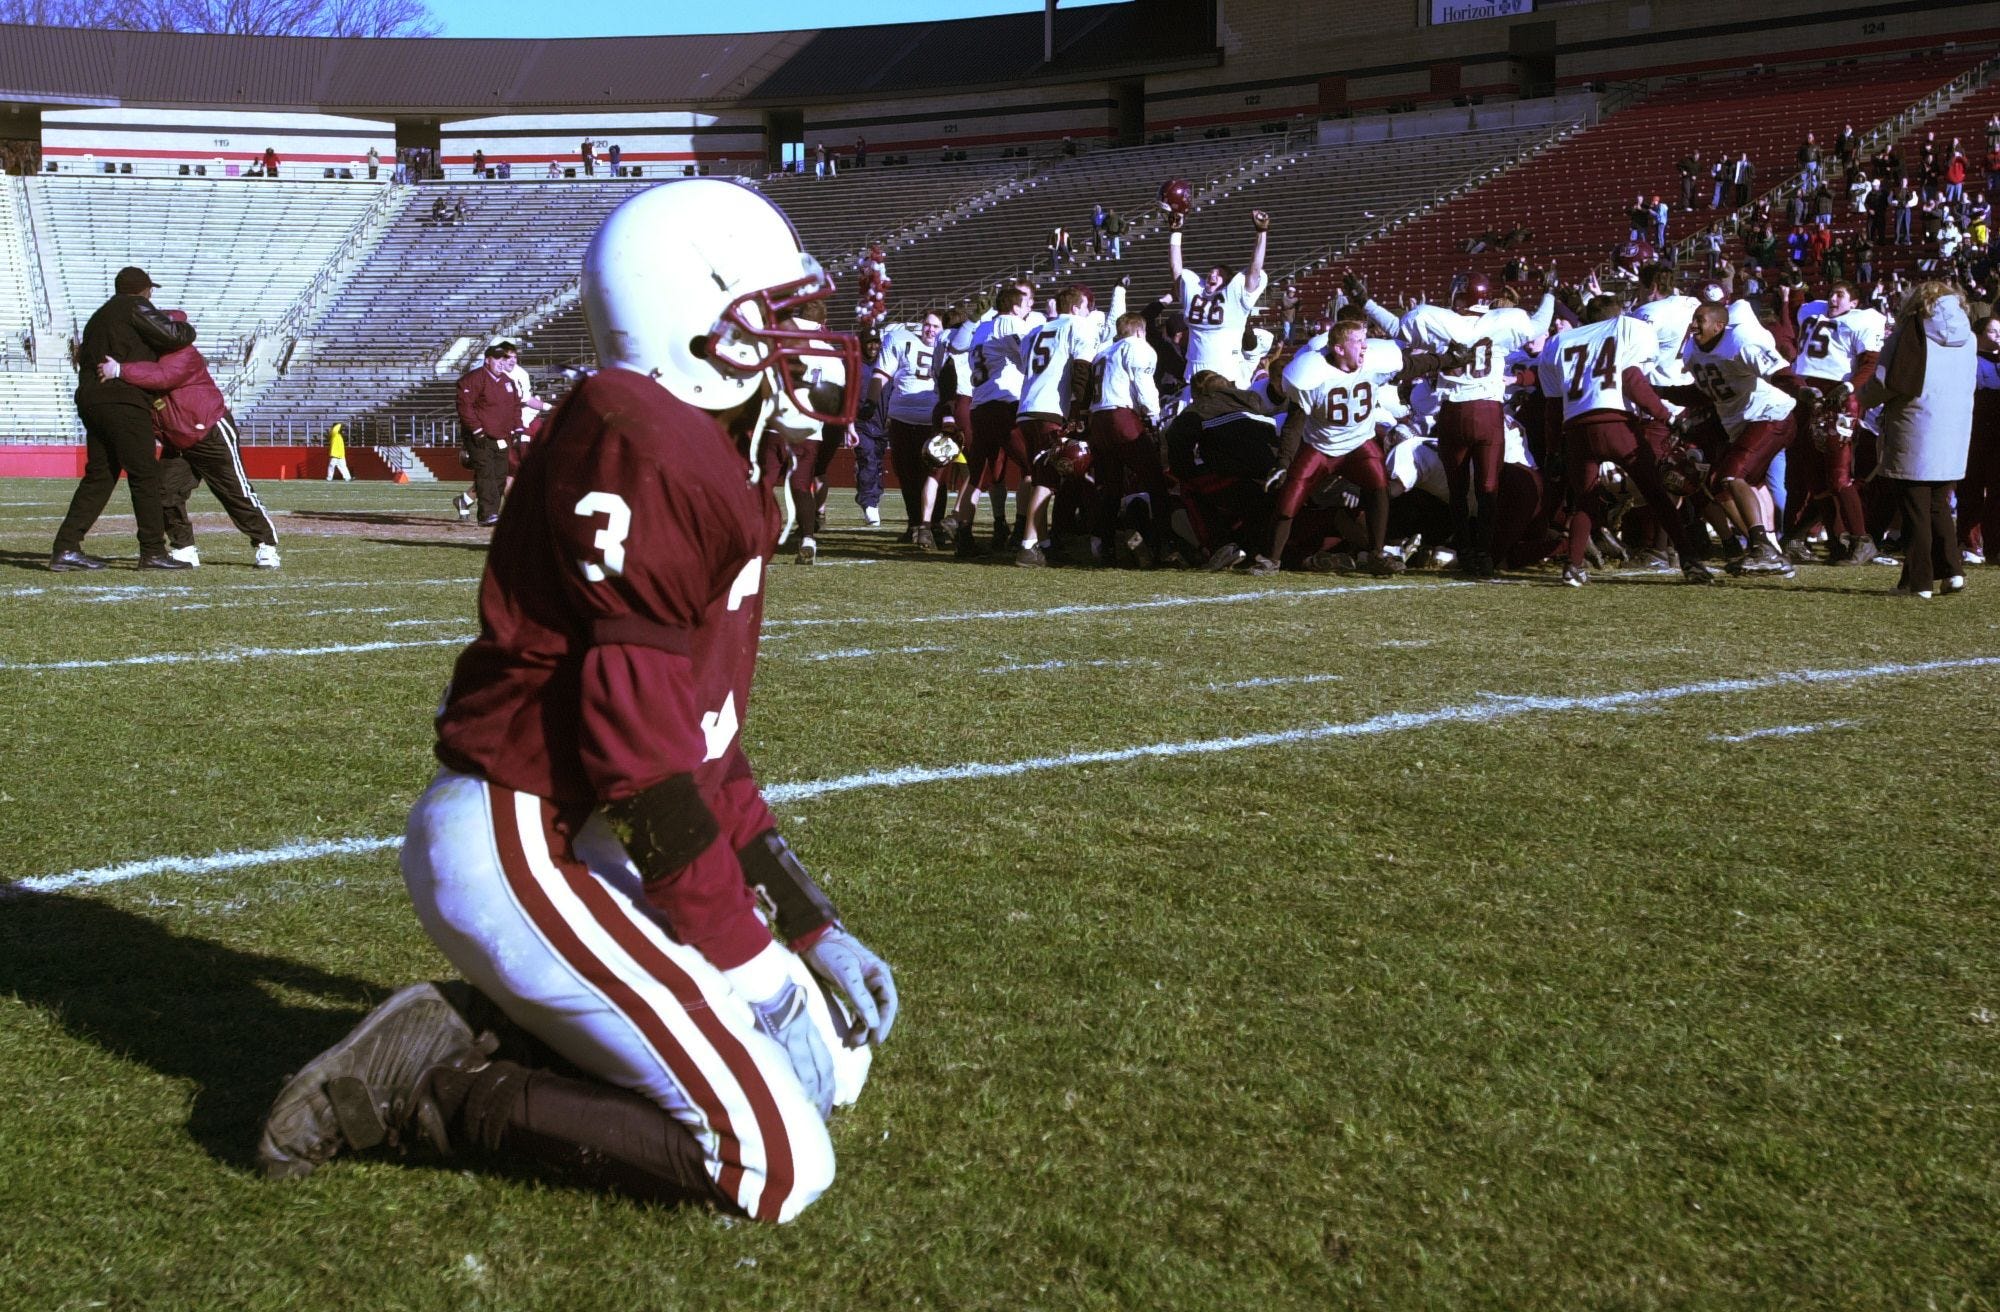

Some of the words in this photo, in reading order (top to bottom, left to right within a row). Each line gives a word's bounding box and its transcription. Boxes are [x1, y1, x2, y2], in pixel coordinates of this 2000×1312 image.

[1443, 4, 1495, 22] Horizon
[1189, 294, 1225, 325] 86
[1564, 336, 1618, 400] 74
[1326, 381, 1373, 427] 63
[574, 491, 631, 582] 3
